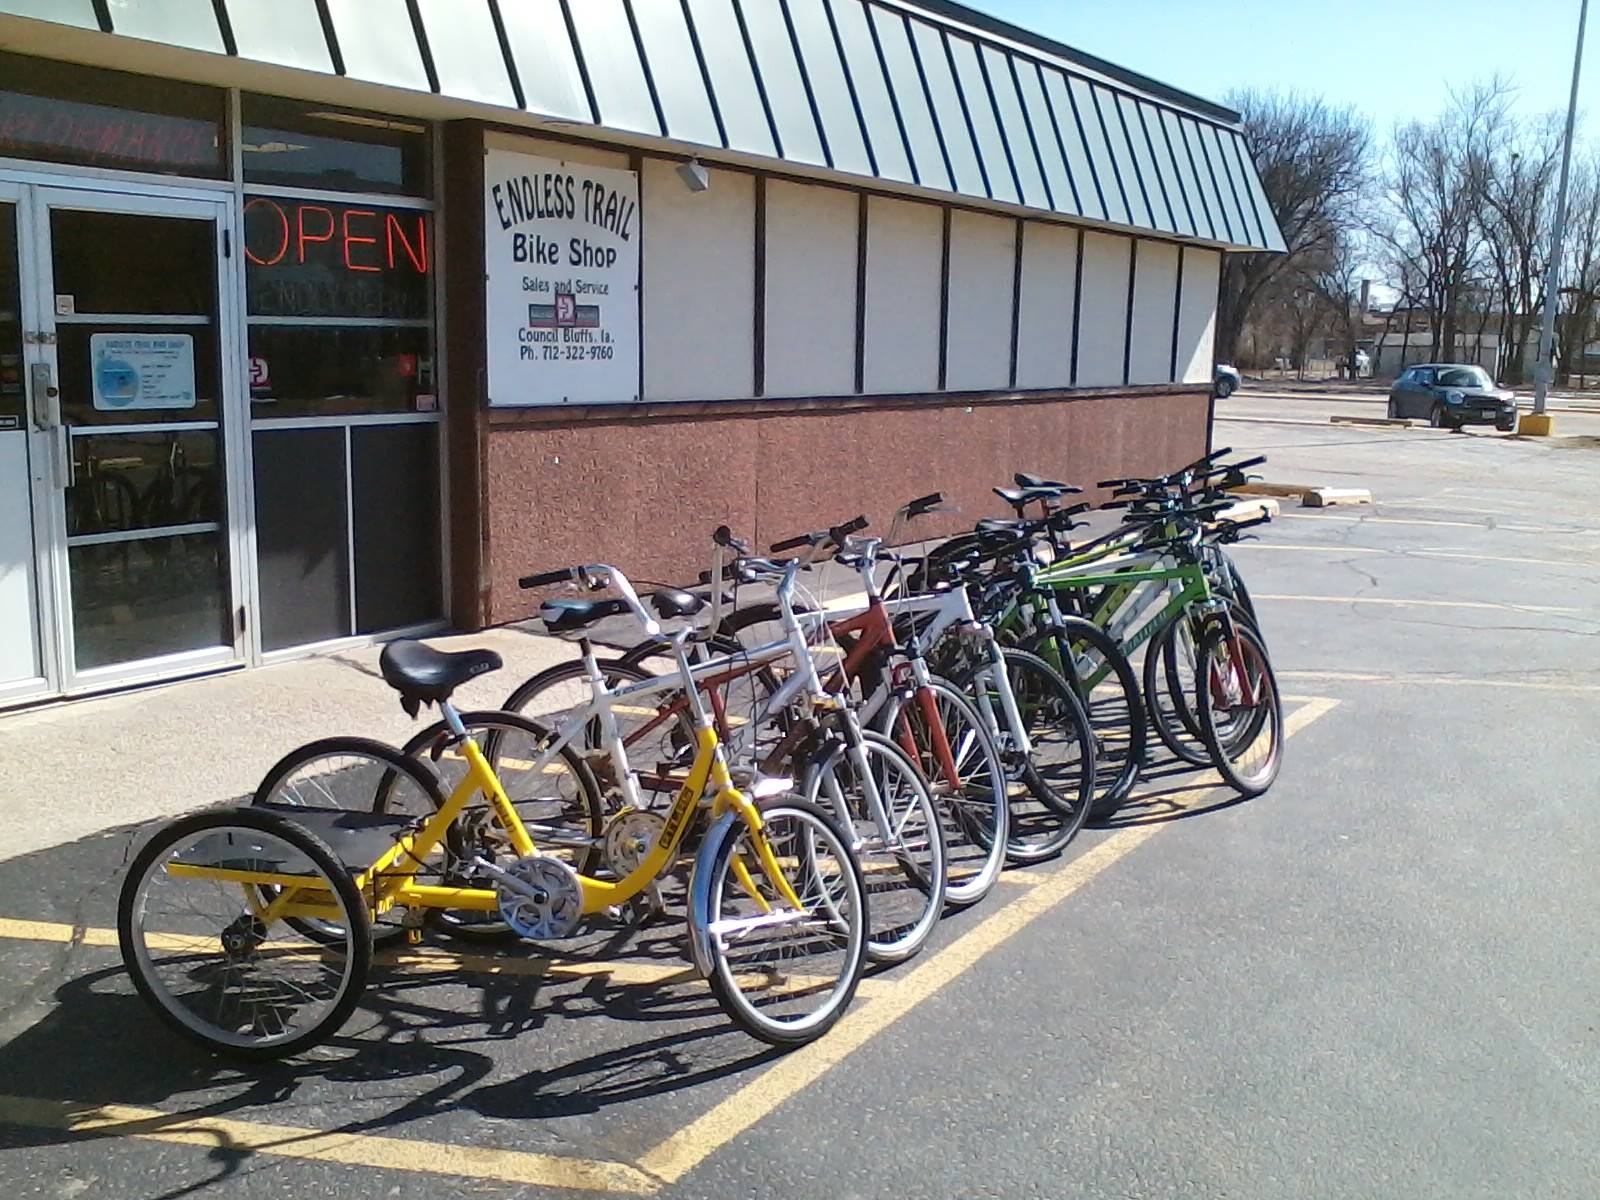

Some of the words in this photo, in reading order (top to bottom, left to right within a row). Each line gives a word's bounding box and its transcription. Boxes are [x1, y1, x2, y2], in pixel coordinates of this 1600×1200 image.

[492, 173, 576, 231] ENDLESS
[582, 179, 635, 242] TRAIL
[244, 199, 428, 273] OPEN
[513, 232, 560, 264] Bike
[569, 237, 617, 269] Shop
[522, 276, 550, 293] Sales
[554, 279, 572, 294] and
[575, 279, 609, 296] Service
[518, 327, 559, 343] Council
[520, 345, 538, 360] Ph.
[542, 346, 614, 361] 712-322-9760
